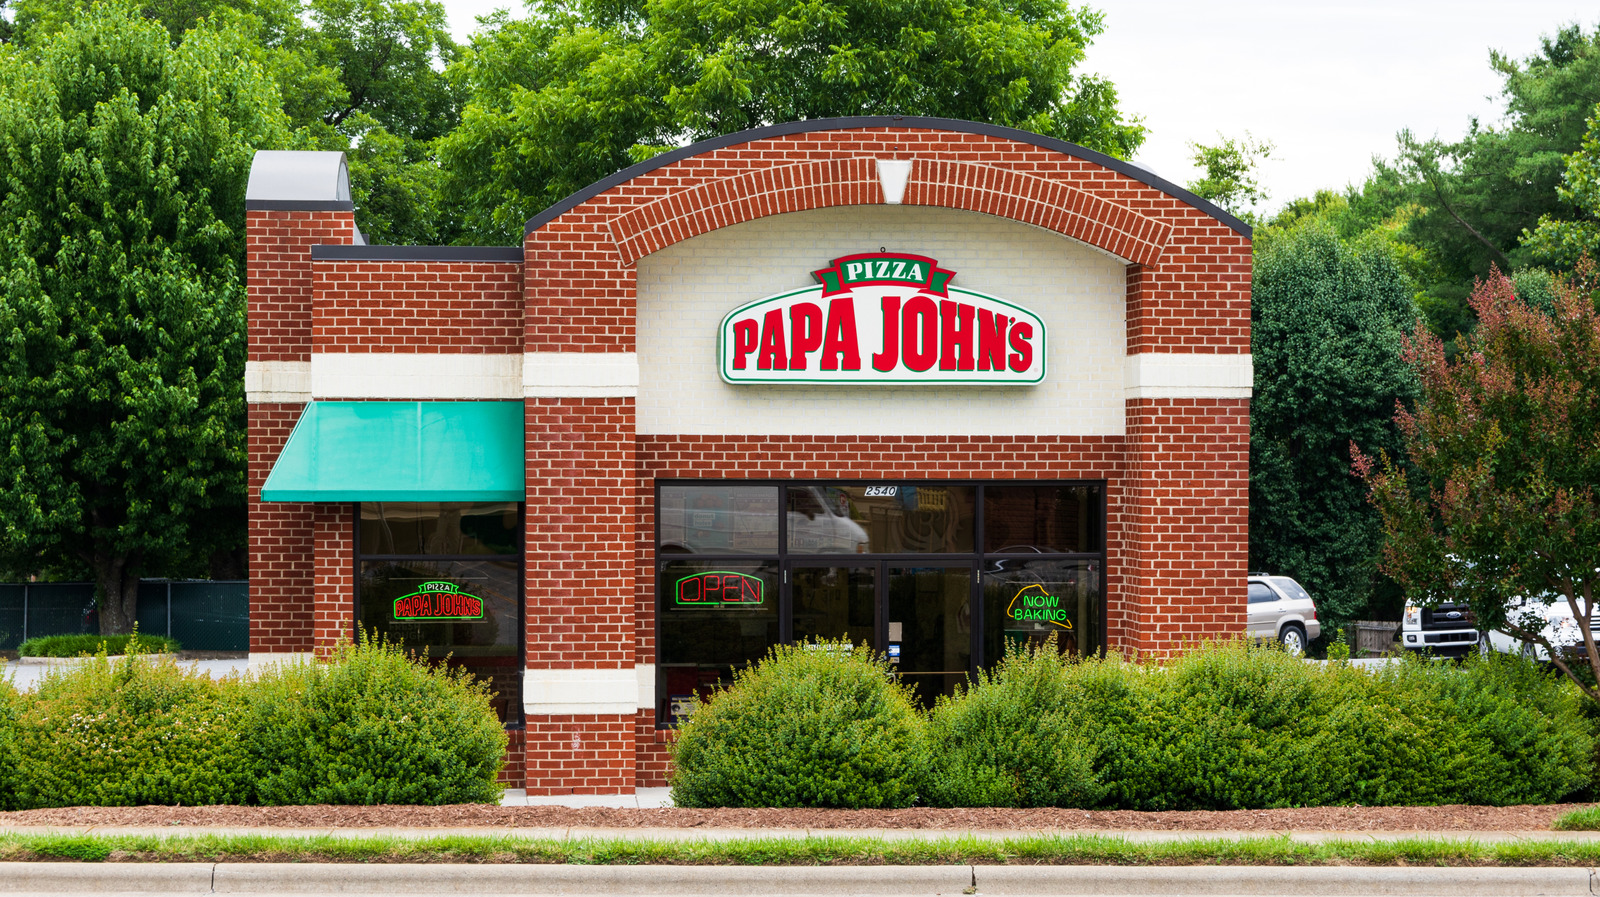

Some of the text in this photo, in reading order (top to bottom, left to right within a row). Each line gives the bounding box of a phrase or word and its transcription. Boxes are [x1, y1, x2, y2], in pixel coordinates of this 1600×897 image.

[846, 261, 924, 282] PIZZA
[732, 296, 1033, 373] PAPA JOHN'S
[866, 486, 896, 495] 2540
[427, 583, 450, 591] PIZZA
[681, 575, 760, 602] OPEN
[395, 594, 432, 616] PAPA
[1023, 595, 1060, 608] NOW
[1014, 608, 1067, 621] BAKING
